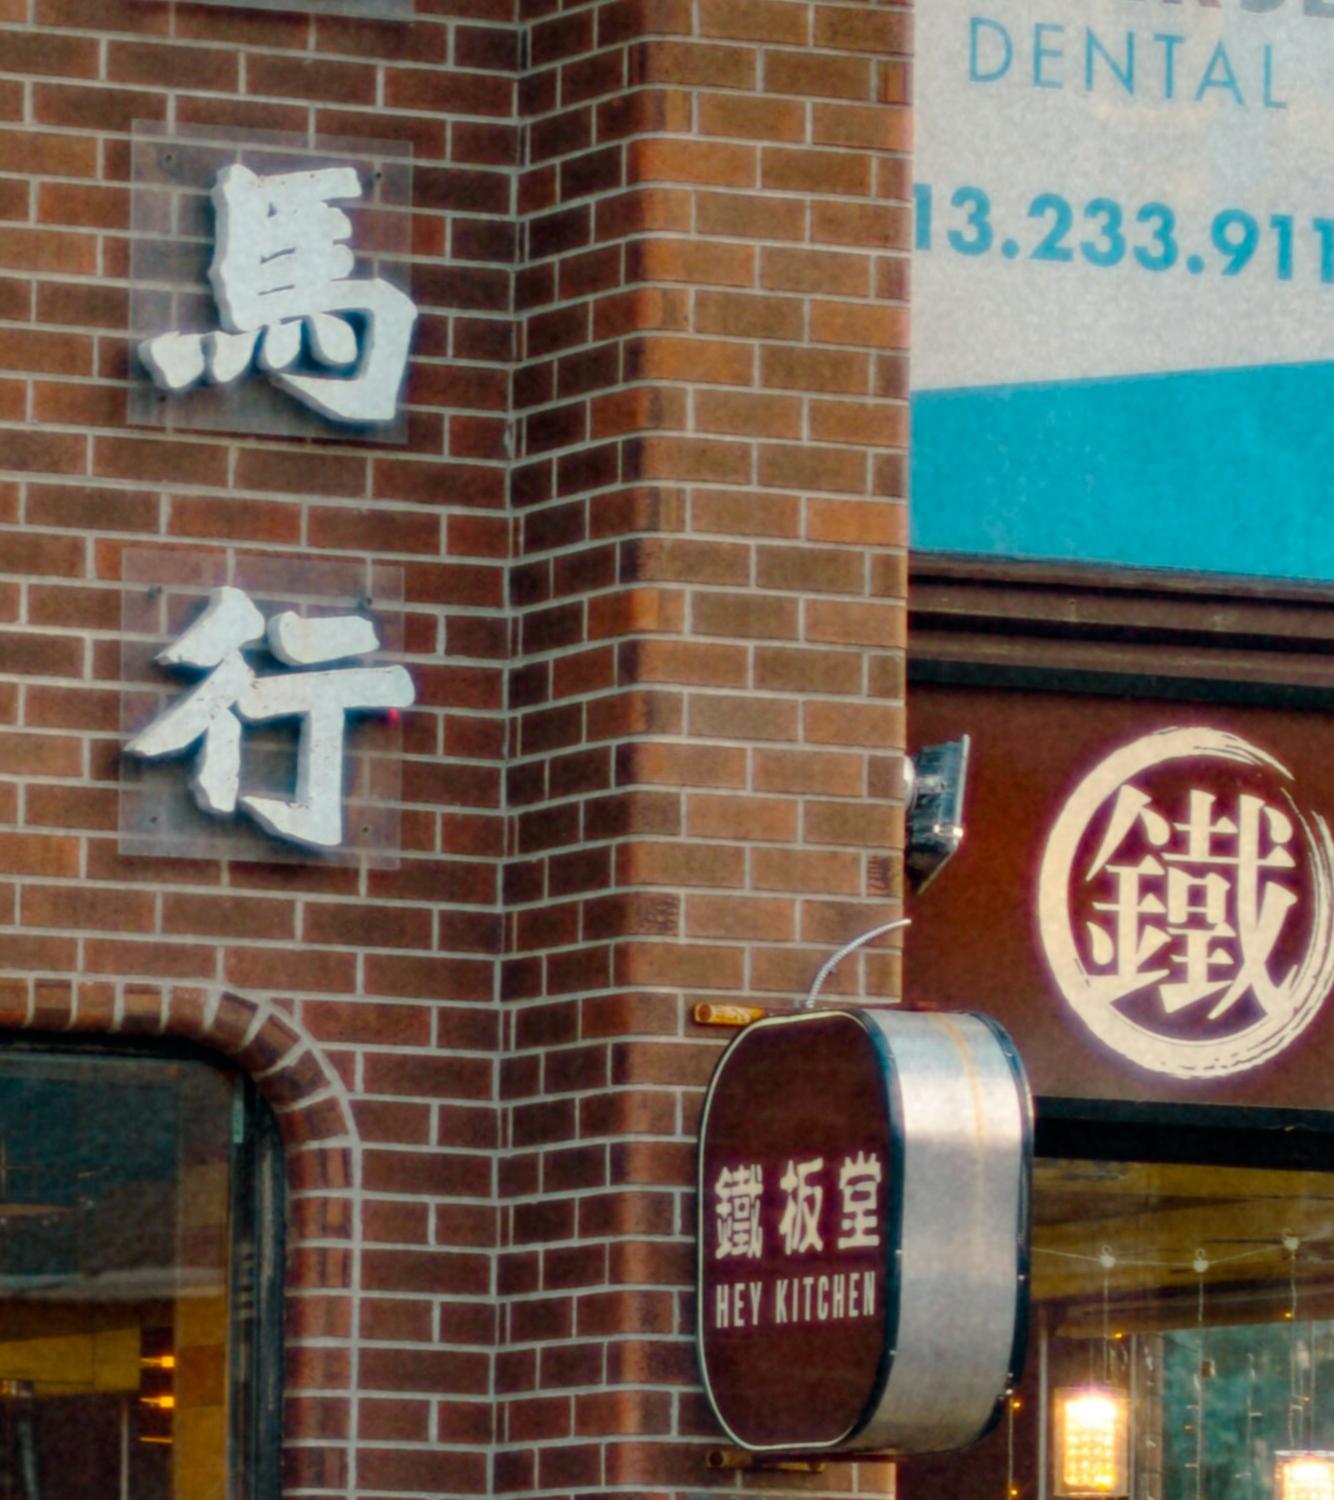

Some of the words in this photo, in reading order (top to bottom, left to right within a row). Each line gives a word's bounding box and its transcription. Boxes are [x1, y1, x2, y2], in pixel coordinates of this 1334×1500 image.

[967, 15, 1290, 110] DENTAL
[714, 1149, 883, 1261] 鐵板堂
[715, 1280, 764, 1330] HEY
[774, 1270, 877, 1324] KITCHEN
